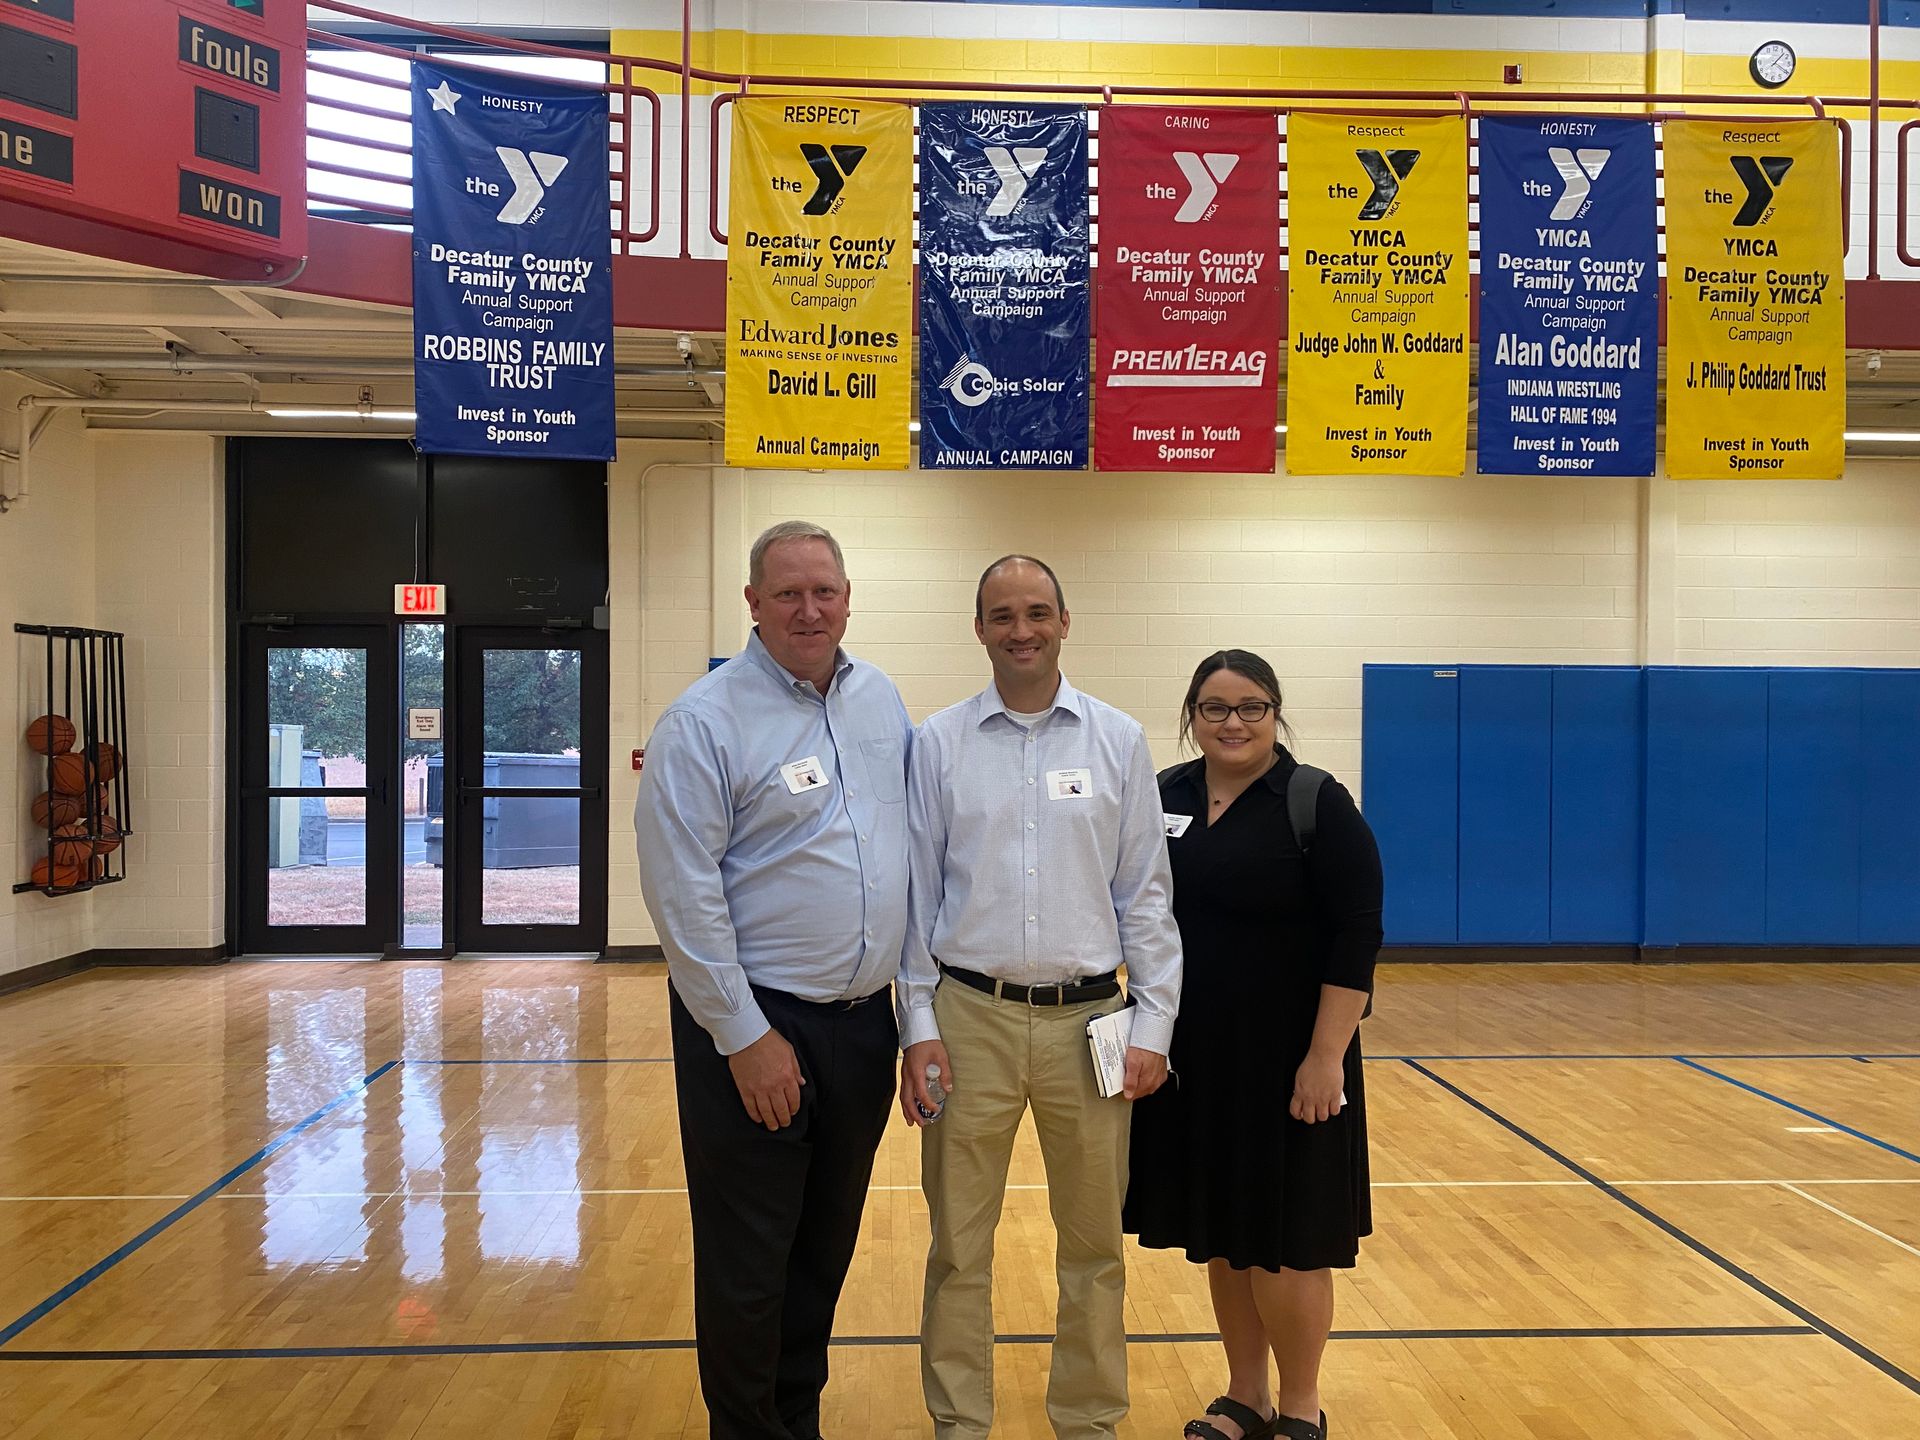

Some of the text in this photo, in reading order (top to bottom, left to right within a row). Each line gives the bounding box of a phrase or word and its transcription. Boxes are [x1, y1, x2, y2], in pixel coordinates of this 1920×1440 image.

[191, 26, 269, 87] fouls
[482, 96, 543, 114] HONESTY
[784, 106, 860, 125] RESPECT
[972, 109, 1034, 125] HONESTY
[1164, 116, 1210, 130] CARING
[1348, 125, 1406, 138] Respect
[1540, 122, 1596, 136] HONESTY
[1722, 130, 1780, 144] Respect
[465, 176, 500, 197] the
[772, 176, 802, 192] the
[957, 180, 986, 194] the
[1146, 183, 1176, 199] the
[1328, 183, 1358, 199] the
[1522, 180, 1552, 196] the
[200, 183, 263, 227] won
[830, 196, 846, 215] YMCA
[1704, 189, 1732, 204] the
[528, 206, 546, 226] YMCA
[1012, 198, 1028, 215] YMCA
[1202, 203, 1219, 222] YMCA
[1576, 200, 1594, 220] YMCA
[1760, 207, 1776, 226] YMCA
[746, 232, 896, 255] Decatur County
[1350, 230, 1406, 248] YMCA
[1536, 228, 1592, 248] YMCA
[1723, 238, 1778, 257] YMCA
[431, 244, 593, 277] Decatur County
[760, 251, 888, 272] Family YMCA
[1116, 247, 1264, 270] Decatur County
[1306, 250, 1454, 270] Decatur County
[1498, 253, 1645, 278] Decatur County
[448, 266, 586, 294] Family YMCA
[772, 272, 818, 287] Annual
[950, 268, 1066, 286] Family YMCA
[1131, 266, 1258, 287] Family YMCA
[1320, 268, 1446, 288] Family YMCA
[1513, 272, 1638, 294] Family YMCA
[1684, 266, 1830, 290] Decatur County
[462, 290, 573, 314] Annual Support
[790, 292, 857, 311] Campaign
[950, 287, 1065, 301] Annual Support
[1144, 287, 1246, 305] Annual Support
[1332, 290, 1434, 306] Annual Support
[1698, 286, 1822, 307] Family YMCA
[972, 303, 1043, 318] Campaign
[1524, 294, 1626, 314] Annual Support
[482, 312, 554, 334] Campaign
[1162, 306, 1227, 324] Campaign
[1351, 308, 1416, 326] Campaign
[1542, 312, 1606, 332] Campaign
[1710, 307, 1810, 326] Annual Support
[1728, 326, 1792, 344] Campaign
[424, 334, 605, 366] ROBBINS FAMILY
[1295, 332, 1464, 358] Judge John W. Goddard
[1495, 333, 1640, 370] Alan Goddard
[740, 349, 898, 363] MAKING SENSE OF INVESTING
[1230, 350, 1266, 376] AG
[486, 364, 557, 389] TRUST
[1374, 358, 1384, 380] &
[768, 369, 876, 398] David L. Gill
[1023, 378, 1066, 392] Solar
[1686, 362, 1826, 396] J. Philip Goddard Trust
[1356, 384, 1404, 410] Family
[1508, 379, 1621, 399] INDIANA WRESTLING
[458, 405, 576, 425] Invest in Youth
[1510, 406, 1617, 425] HALL OF FAME 1994
[486, 426, 550, 444] Sponsor
[1133, 426, 1240, 441] Invest in Youth
[1326, 426, 1432, 441] Invest in Youth
[756, 435, 880, 462] Annual Campaign
[1158, 444, 1216, 462] Sponsor
[1350, 445, 1407, 462] Sponsor
[1513, 436, 1620, 452] Invest in Youth
[1704, 438, 1809, 451] Invest in Youth
[936, 450, 1073, 464] ANNUAL CAMPAIGN
[1538, 455, 1594, 471] Sponsor
[1729, 455, 1784, 472] Sponsor
[404, 586, 437, 612] EXIT
